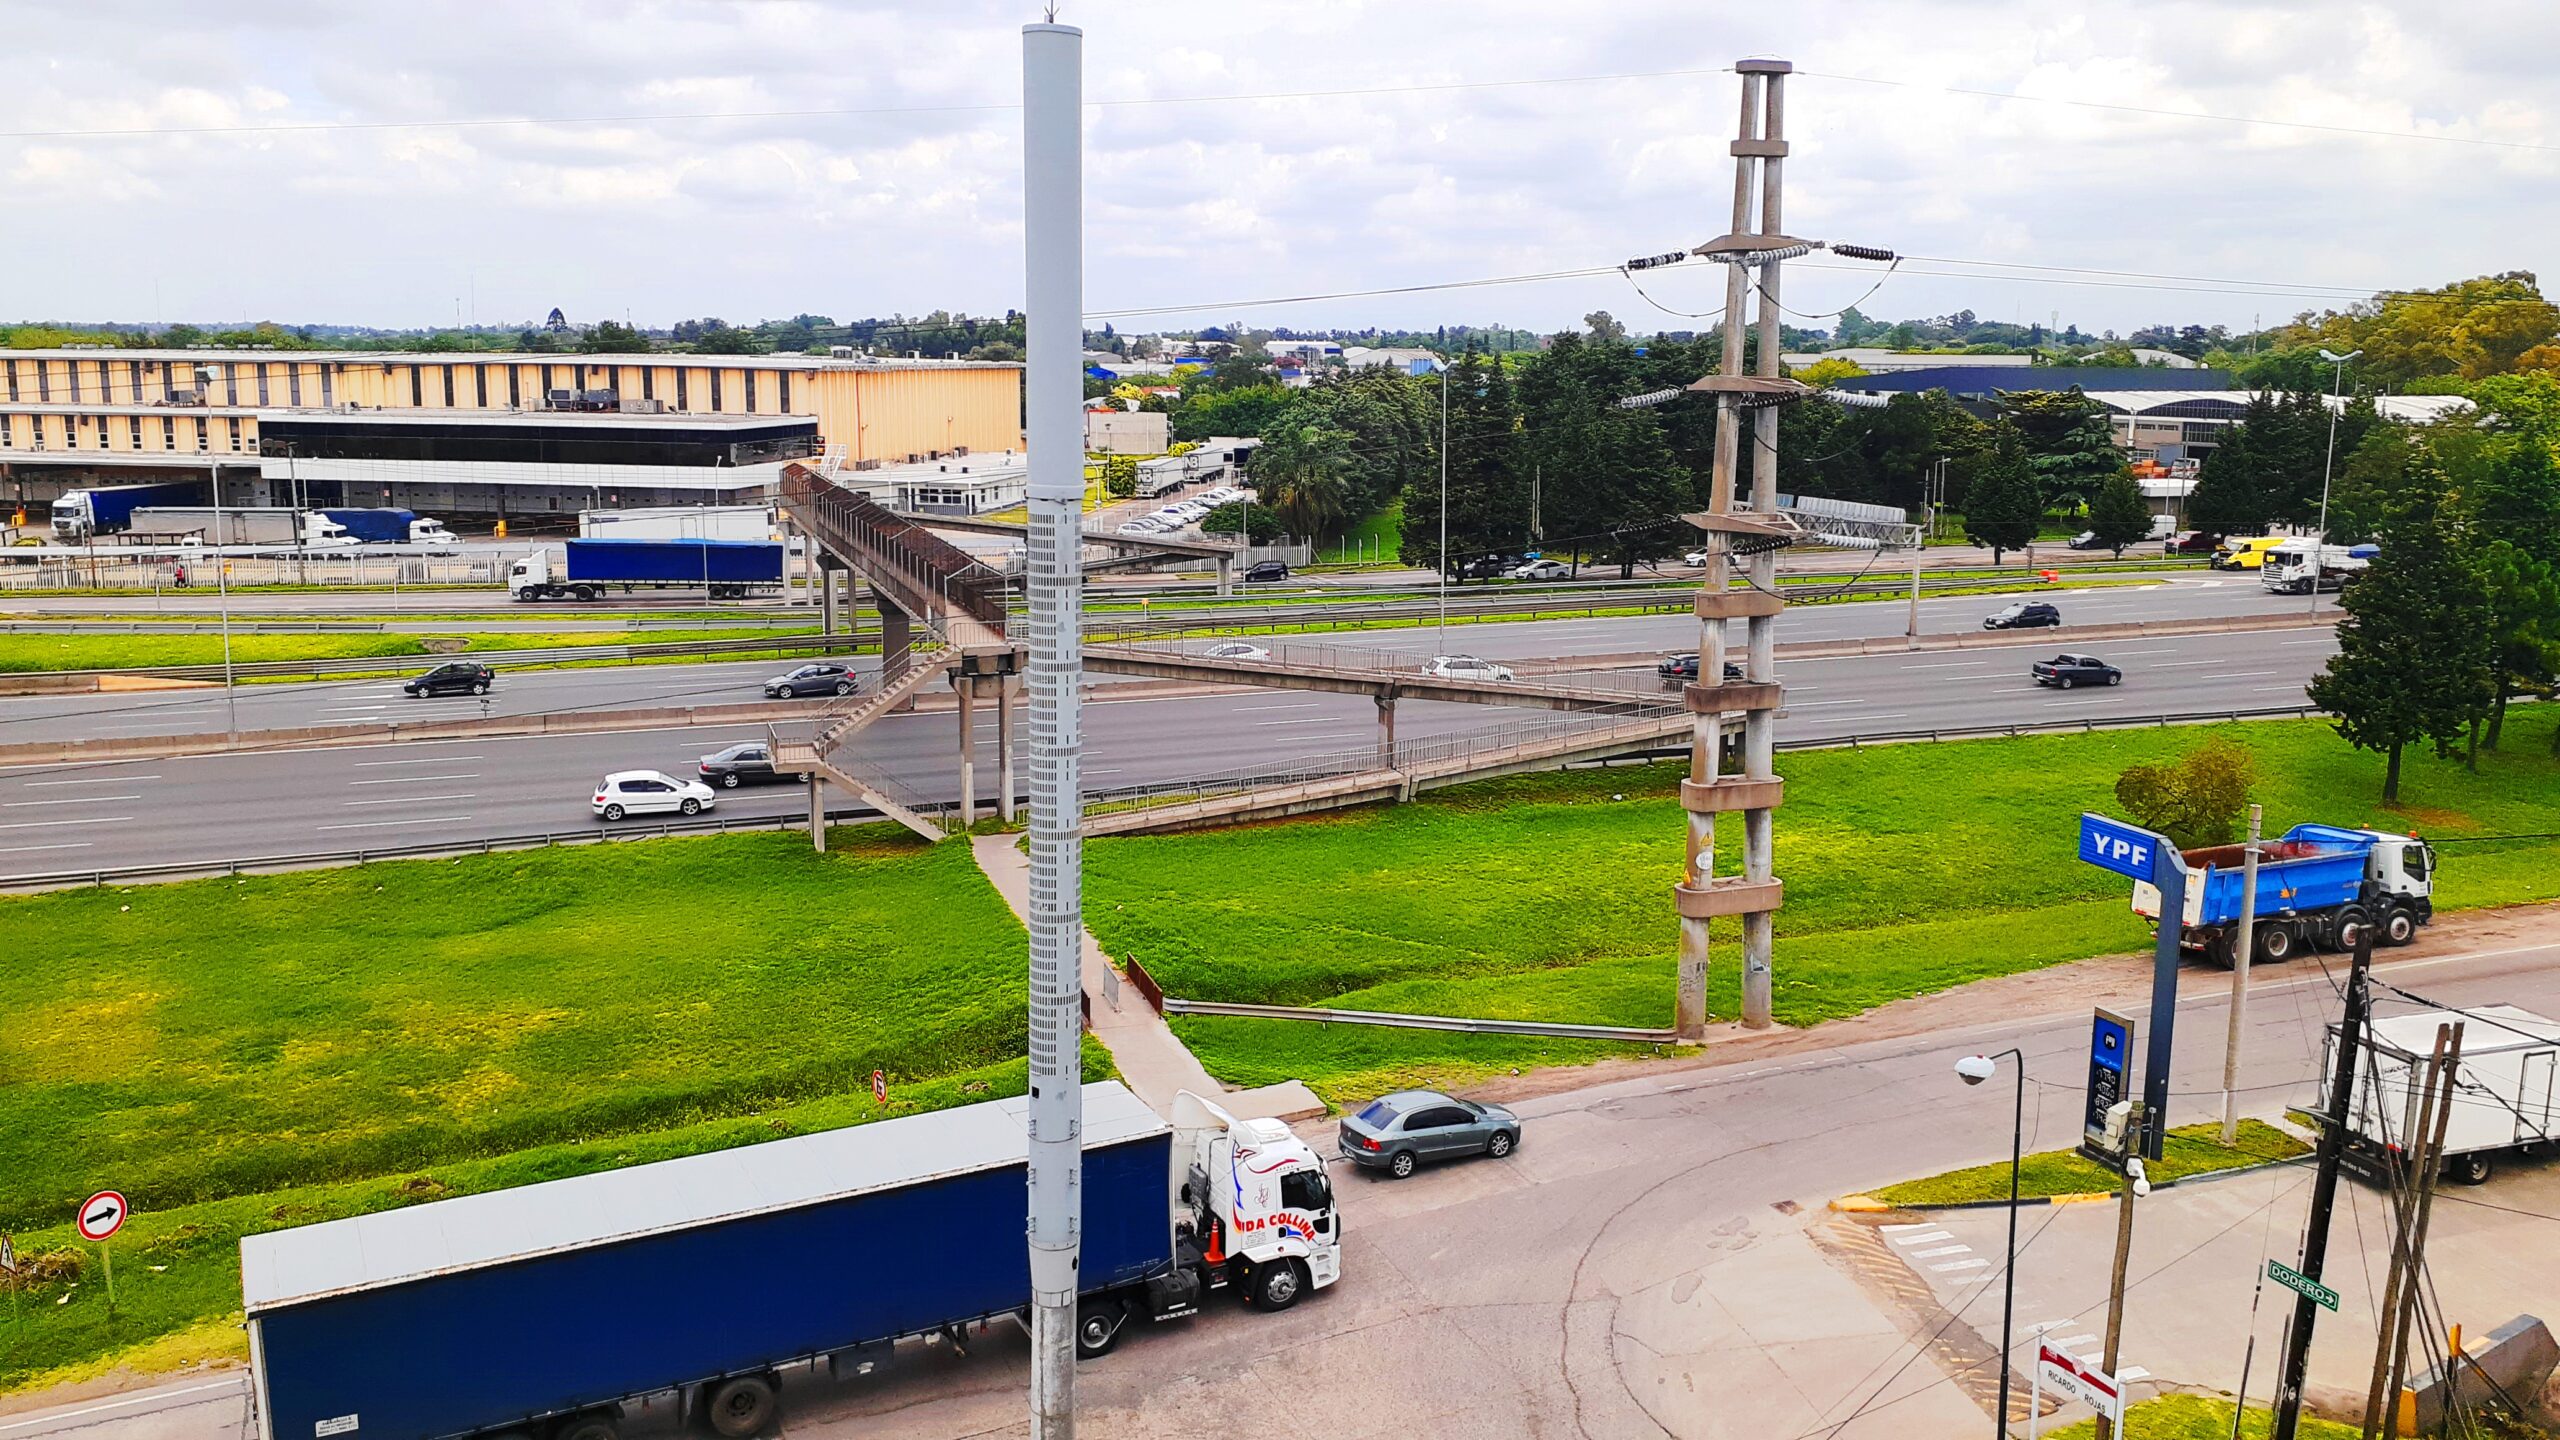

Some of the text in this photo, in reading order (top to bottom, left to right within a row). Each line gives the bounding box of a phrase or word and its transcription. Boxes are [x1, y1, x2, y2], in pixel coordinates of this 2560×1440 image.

[1137, 468, 1153, 483] NB
[2092, 831, 2148, 866] YPF
[1269, 1212, 1316, 1242] COLLINA
[2271, 1265, 2325, 1300] DODERO
[2047, 1369, 2077, 1394] RICARDO
[2084, 1393, 2107, 1414] ROJAS
